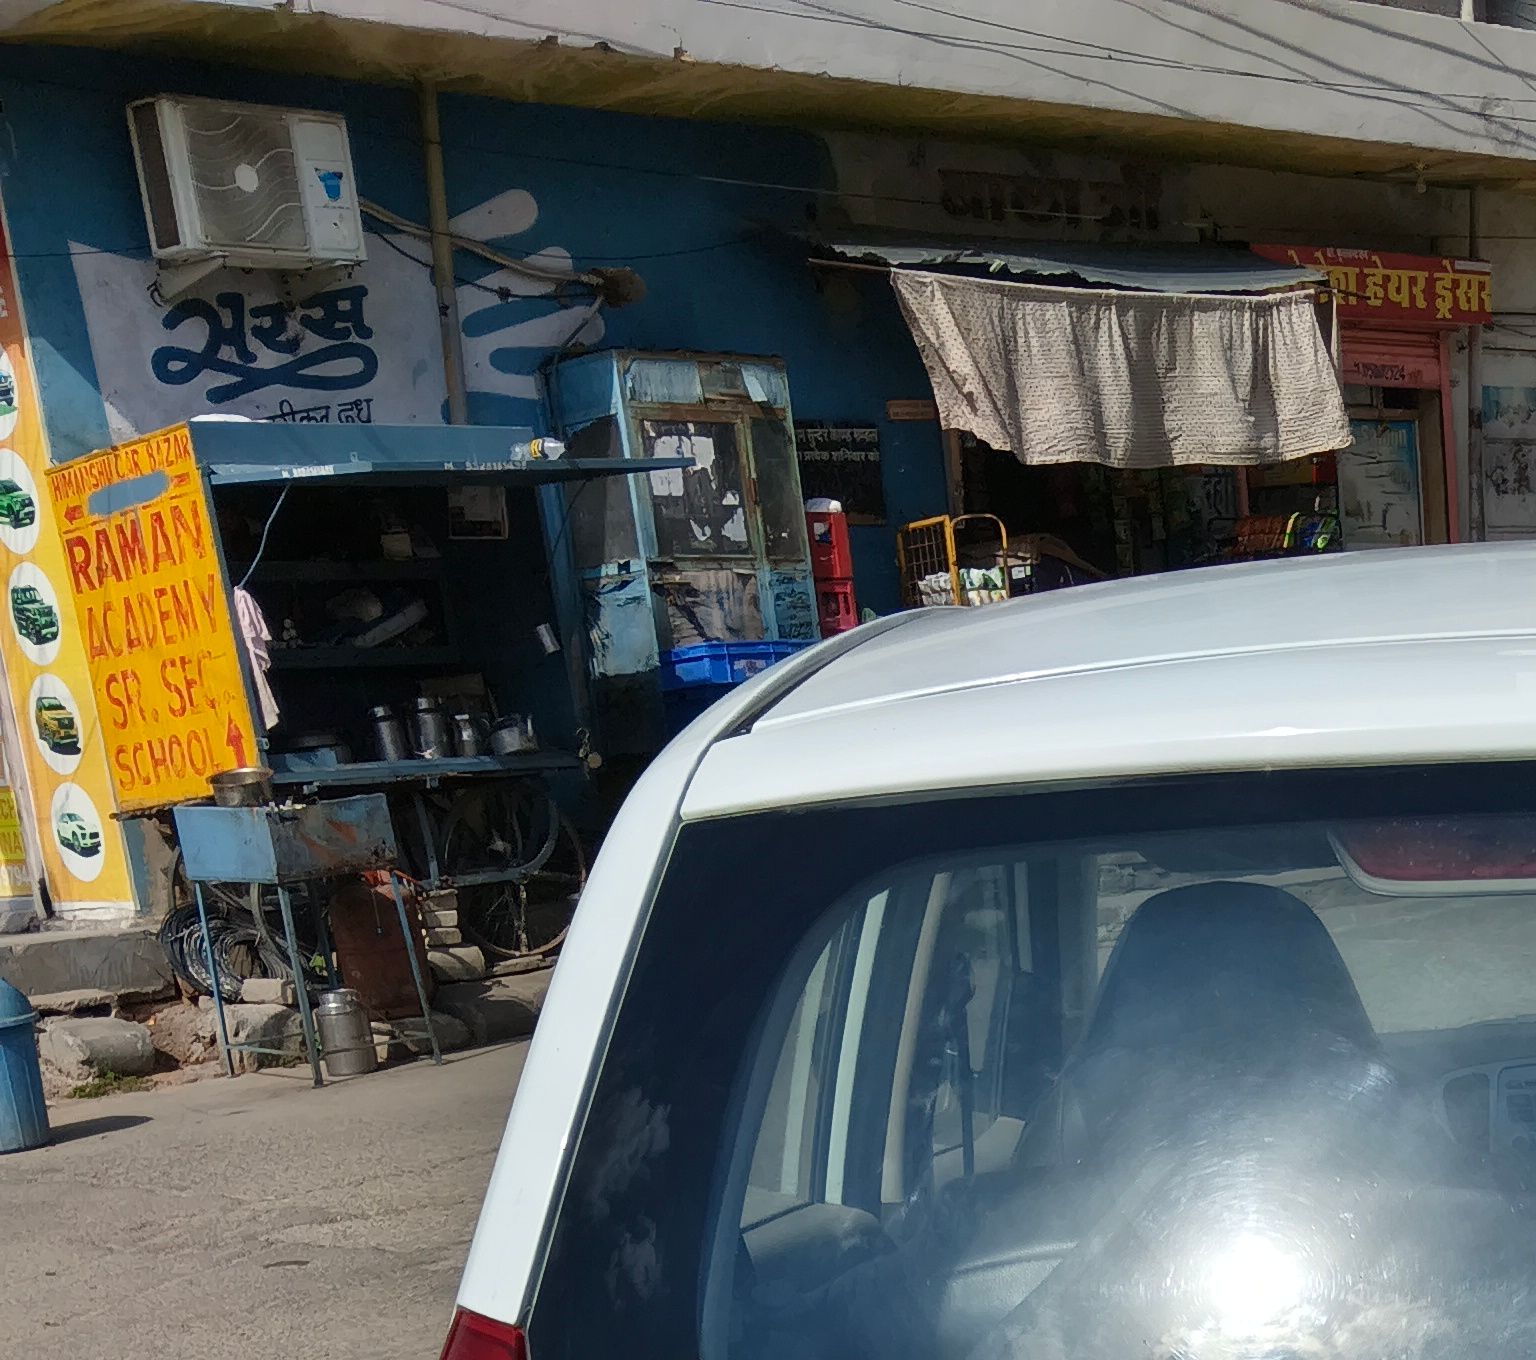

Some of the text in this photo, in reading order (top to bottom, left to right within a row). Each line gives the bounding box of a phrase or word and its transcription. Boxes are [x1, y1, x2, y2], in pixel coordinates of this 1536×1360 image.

[1362, 255, 1430, 309] हेयर
[151, 284, 378, 405] सरस
[52, 432, 191, 502] HIMANSHU CAR BAZAR
[65, 499, 206, 595] RAMAN
[86, 573, 218, 665] ACADEMY
[115, 728, 223, 792] SCHOOL
